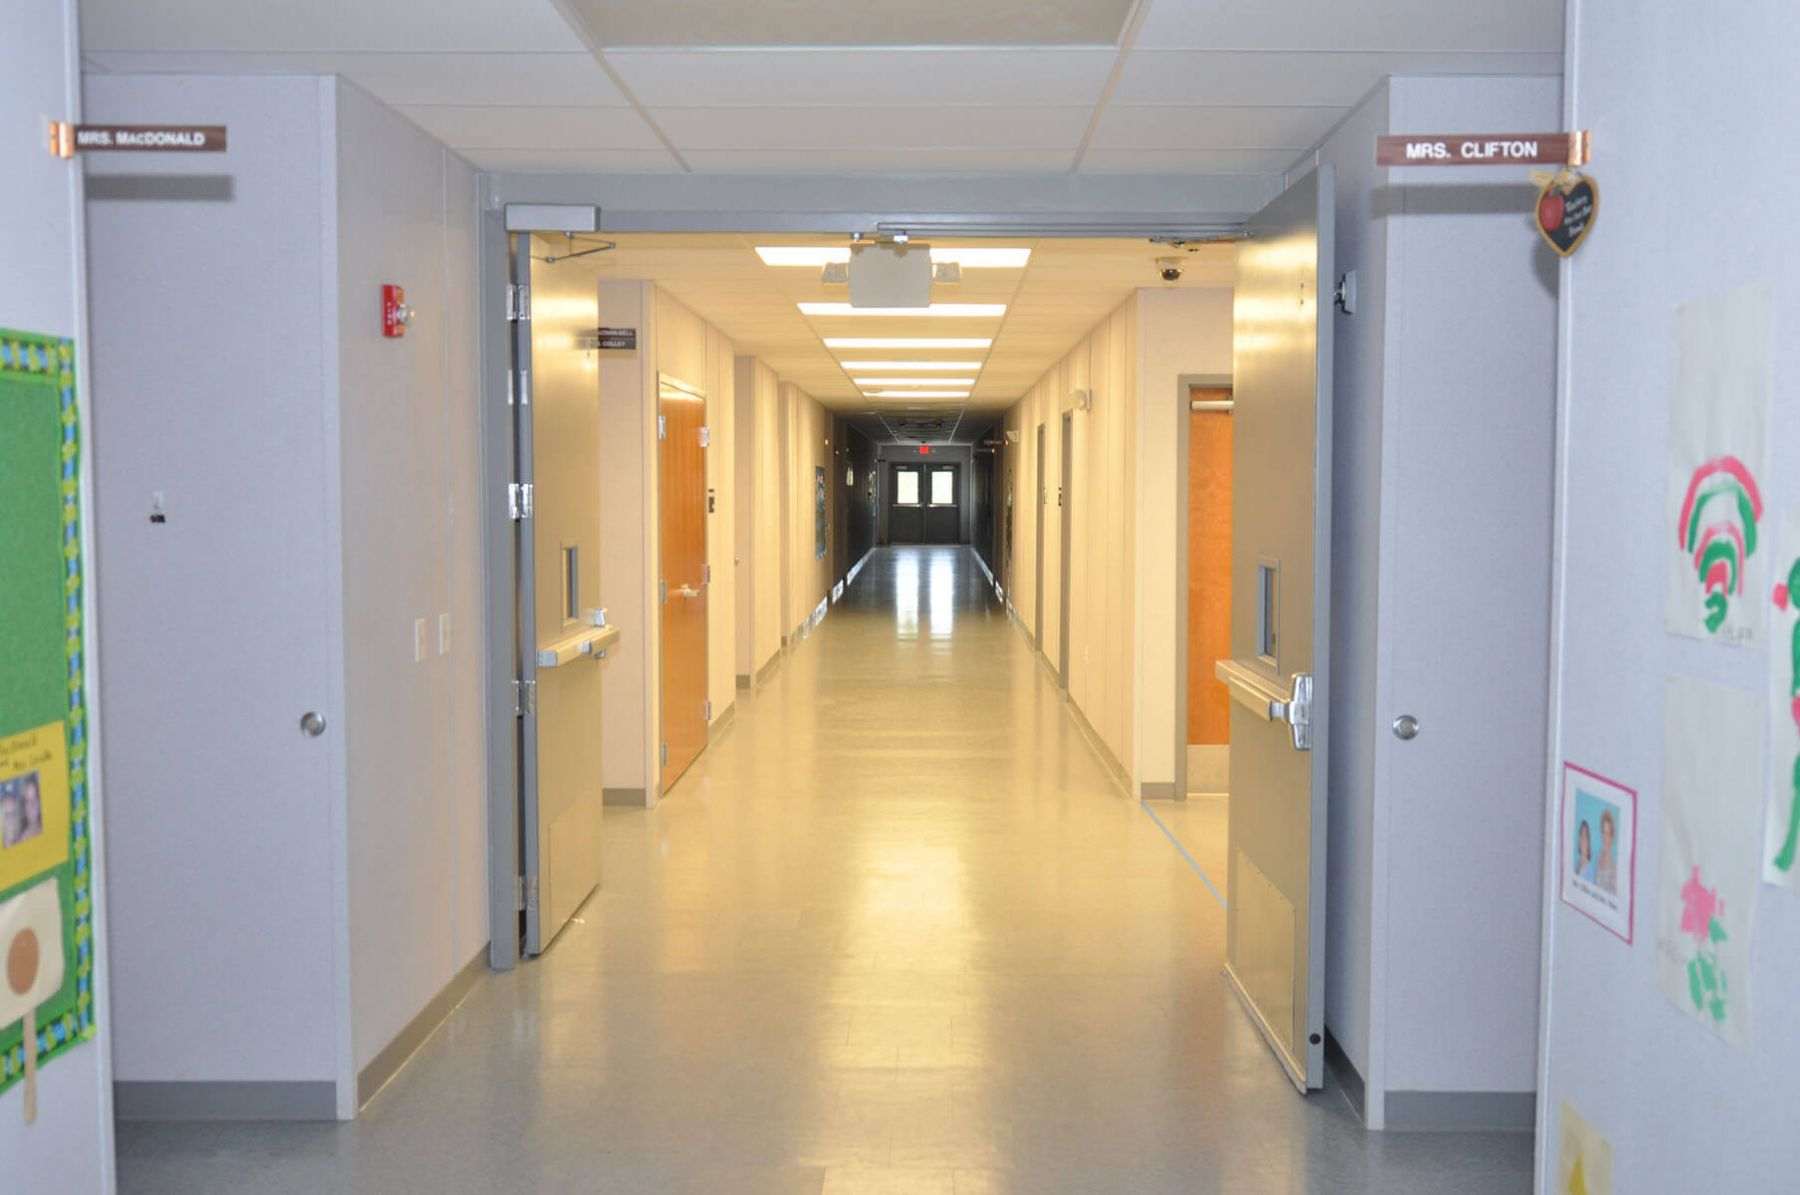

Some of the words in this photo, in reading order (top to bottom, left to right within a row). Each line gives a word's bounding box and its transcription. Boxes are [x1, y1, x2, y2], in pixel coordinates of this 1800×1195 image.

[77, 131, 114, 145] MRS.
[1406, 143, 1452, 159] MRS.
[1460, 141, 1538, 158] CLIFTON
